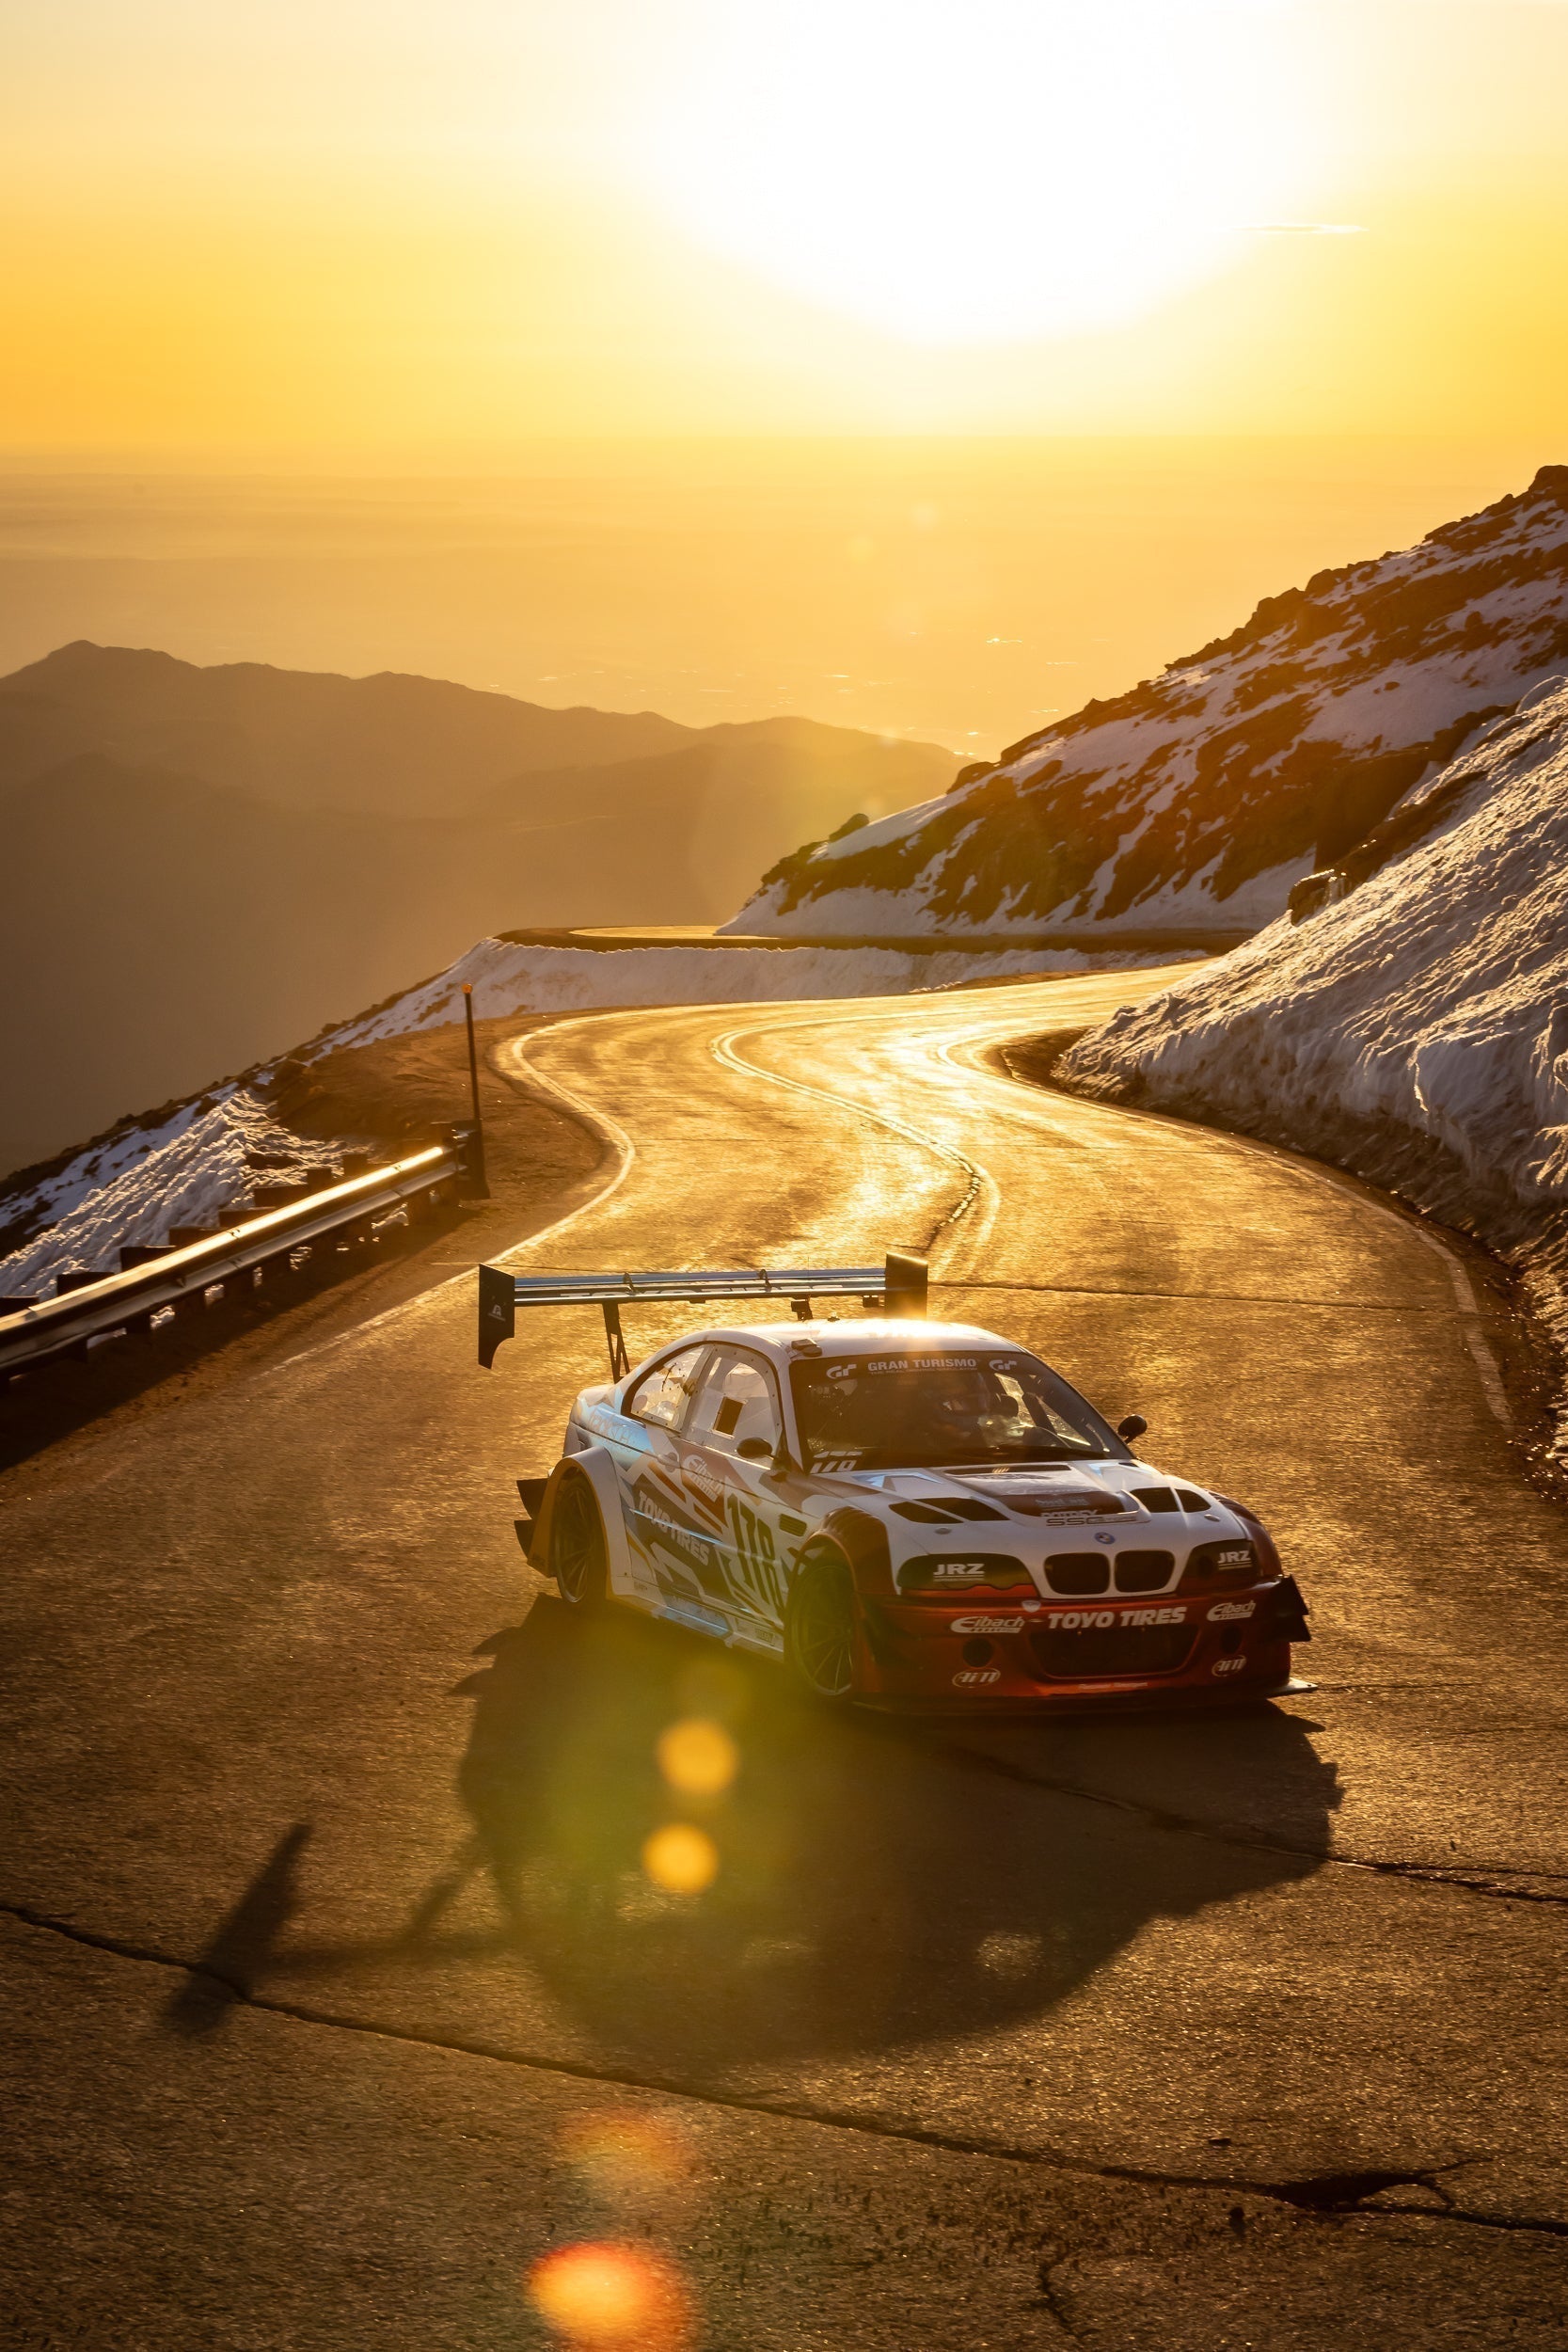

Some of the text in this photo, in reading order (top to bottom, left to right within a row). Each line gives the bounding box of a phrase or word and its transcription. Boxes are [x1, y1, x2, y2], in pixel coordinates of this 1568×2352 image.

[867, 1359, 908, 1372] GRAN
[912, 1358, 976, 1369] TURISMO
[638, 1490, 710, 1566] TOYO TIRES
[1217, 1549, 1252, 1565] JRZ
[933, 1563, 985, 1576] JRZ
[1048, 1606, 1188, 1629] TOYO TIRES
[1206, 1600, 1257, 1622] Eibach
[950, 1615, 1025, 1633] Eibach
